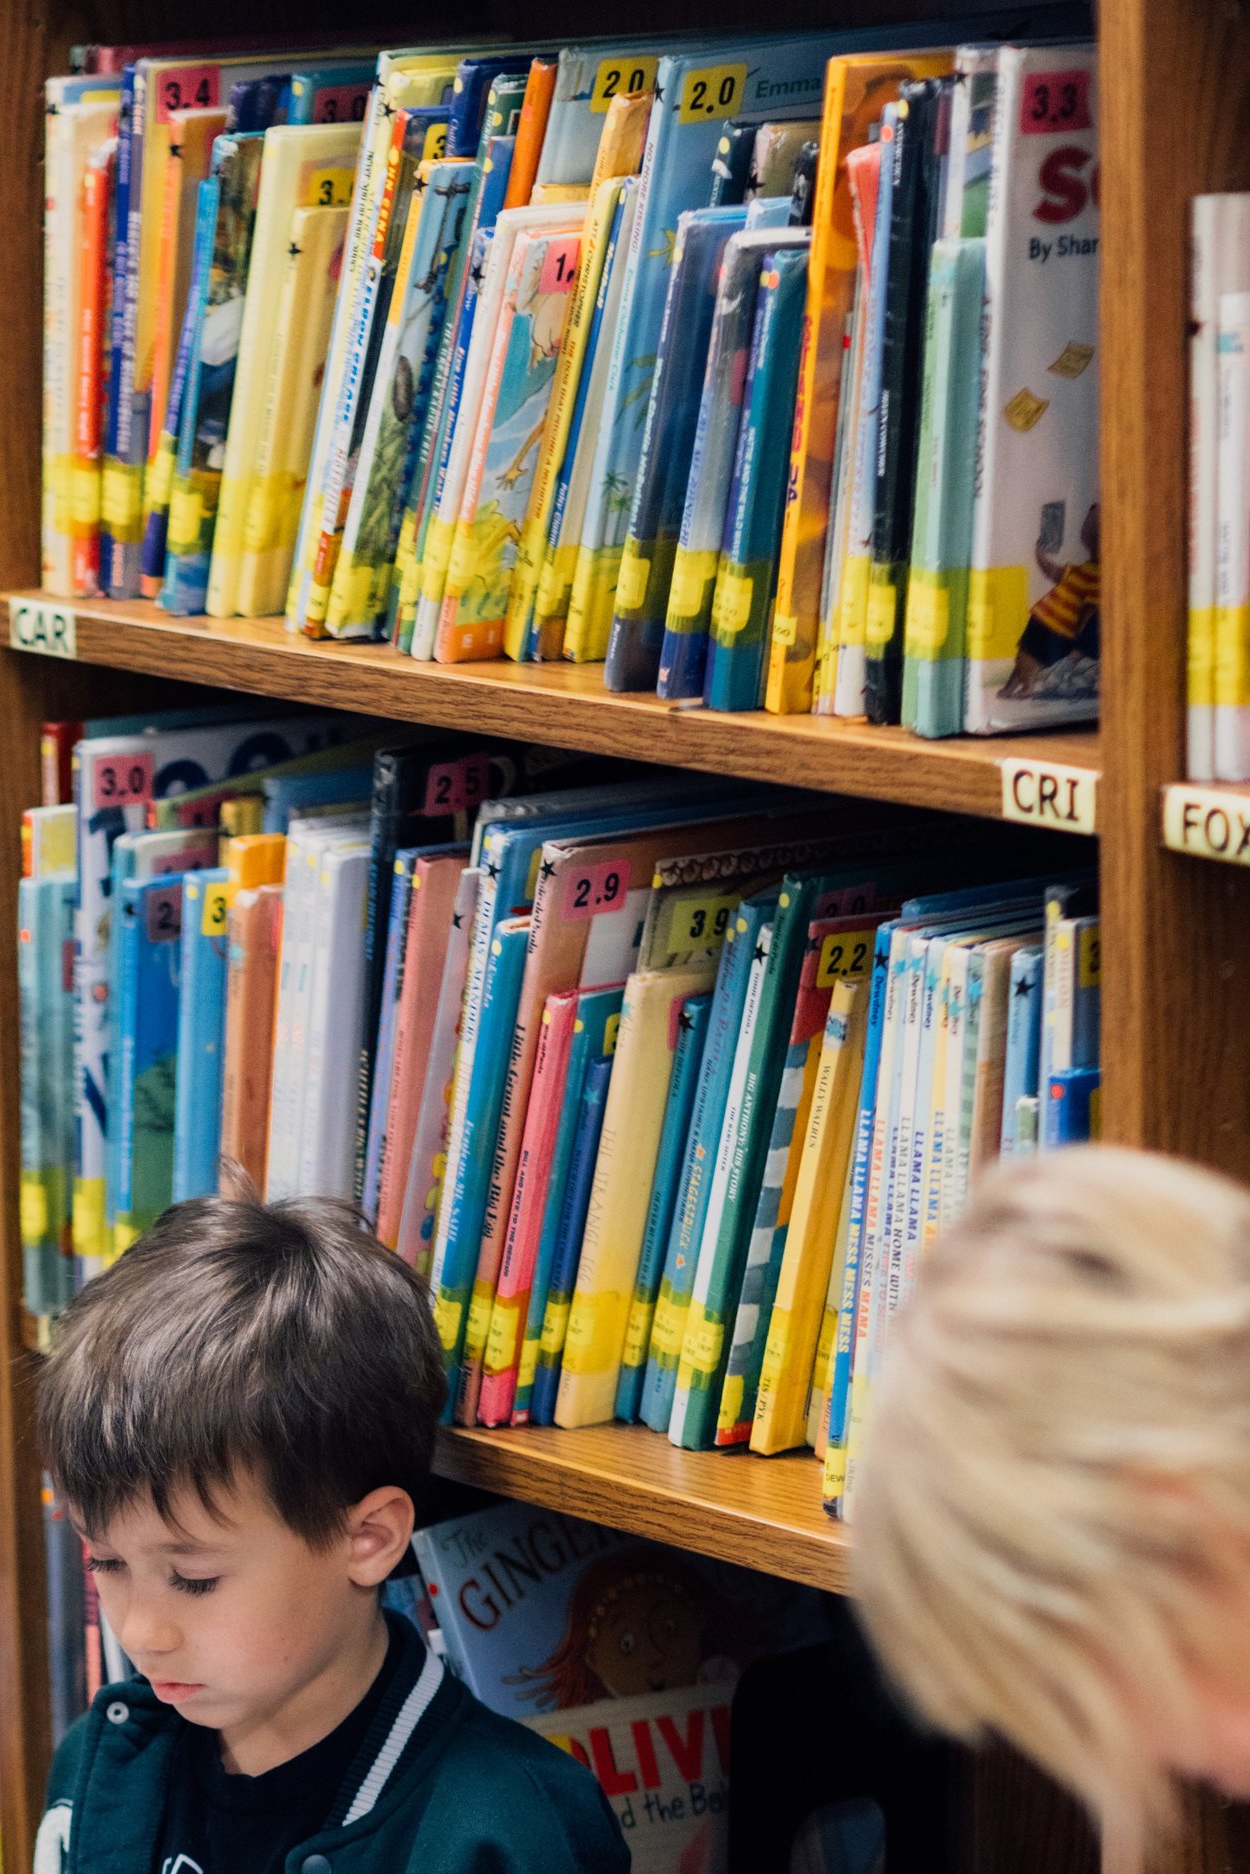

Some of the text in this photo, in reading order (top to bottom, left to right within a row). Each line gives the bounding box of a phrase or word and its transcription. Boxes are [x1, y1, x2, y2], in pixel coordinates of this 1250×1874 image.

[165, 79, 211, 111] 3.4
[689, 76, 736, 113] 2.0
[755, 74, 822, 99] Emma
[1032, 84, 1078, 122] 3.3
[629, 142, 654, 253] NO MORE KISSING!
[1028, 237, 1054, 265] By
[572, 249, 594, 327] CHRISTOPHER
[649, 357, 664, 397] When
[639, 398, 657, 453] Charlie
[16, 607, 70, 654] CAR
[101, 765, 146, 798] 3.0
[1012, 769, 1080, 822] CRI
[573, 872, 621, 909] 2.9
[826, 942, 869, 977] 2.2
[870, 974, 885, 1027] Dewdney
[906, 972, 921, 1025] Dewdney
[745, 1071, 757, 1093] BIG
[728, 1105, 736, 1121] THE
[806, 1063, 831, 1150] WALLY WALRUS
[481, 1022, 526, 1239] Little Grunt and the Big Egg
[597, 1126, 617, 1159] THE
[897, 1117, 910, 1170] LLAMA
[517, 1168, 526, 1189] AND
[521, 1149, 530, 1168] BILL
[731, 1146, 744, 1166] HIS
[925, 1110, 946, 1221] LLAMA LLAMA
[513, 1189, 523, 1211] PETE
[582, 1167, 609, 1247] STRANGE
[676, 1163, 704, 1250] STAGESTRUCK
[893, 1171, 906, 1225] LLAMA
[905, 1130, 925, 1242] LLAMA LLAMA
[837, 1108, 872, 1354] LLAMA LLAMA MESS MESS MESS
[857, 1118, 885, 1340] LLAMA LLAMA MISSES MAMA
[883, 1183, 895, 1237] LLAMA
[508, 1226, 516, 1243] THE
[890, 1225, 903, 1272] HOME
[501, 1243, 513, 1278] RESCUE
